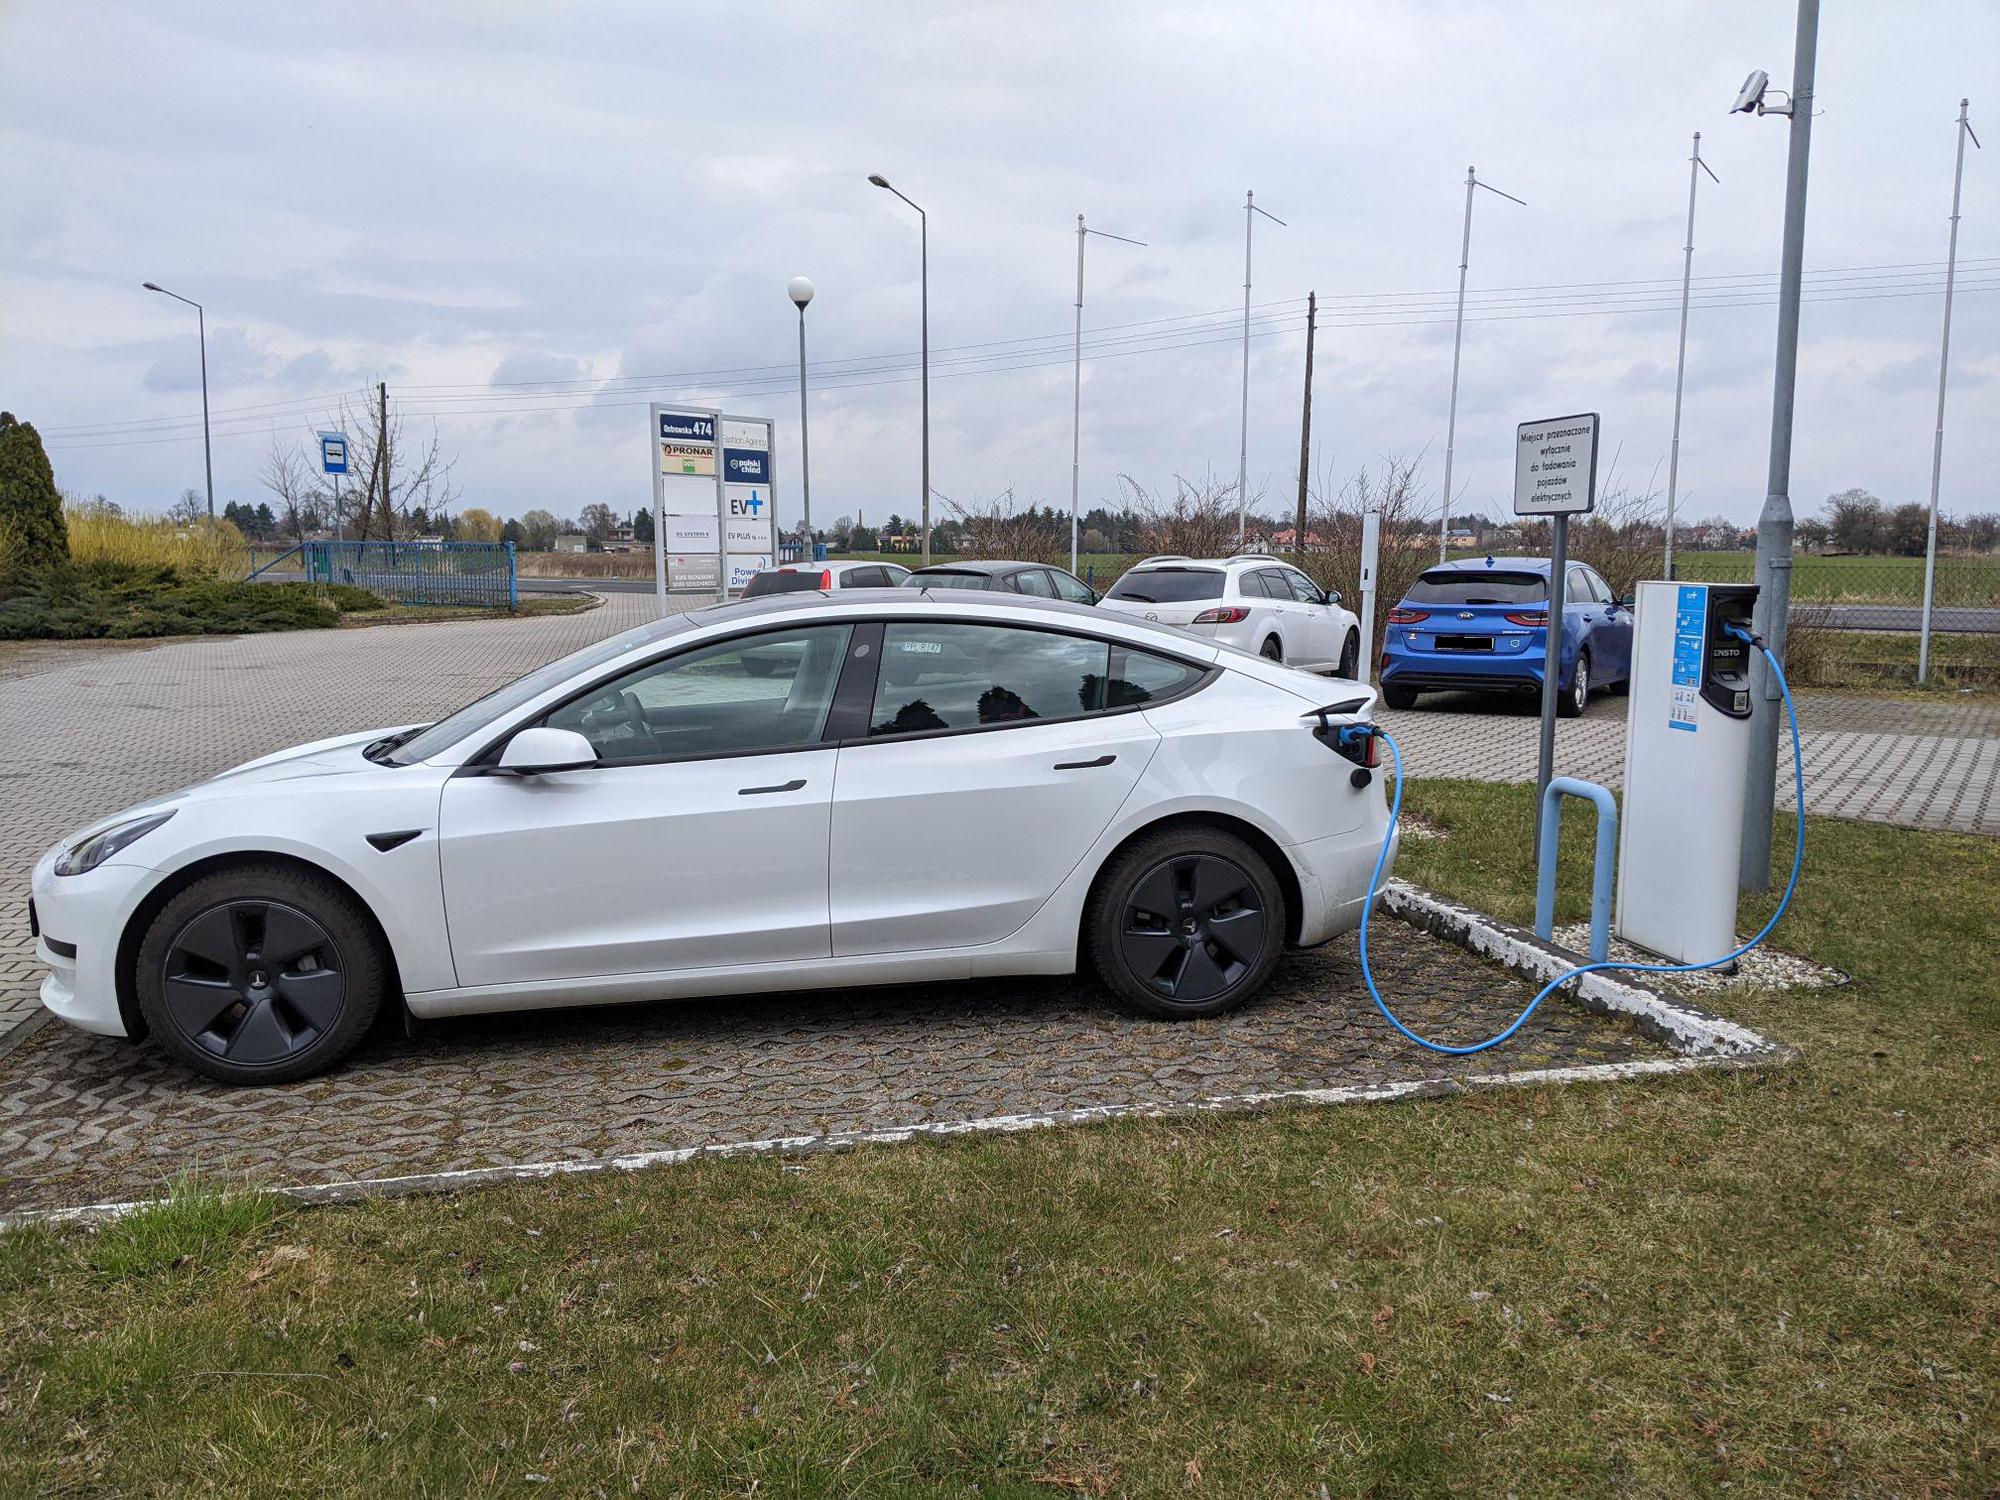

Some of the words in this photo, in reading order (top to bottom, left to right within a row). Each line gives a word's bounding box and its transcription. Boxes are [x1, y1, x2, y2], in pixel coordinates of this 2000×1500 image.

[693, 421, 713, 436] 474
[1520, 432, 1544, 444] Miejsce
[1547, 426, 1590, 441] przeznaczone
[745, 436, 767, 448] Agency
[673, 446, 713, 456] PRONAR
[739, 459, 760, 467] polski
[1530, 461, 1539, 472] do
[1531, 491, 1571, 504] elektrycznych
[727, 532, 736, 540] EV
[736, 532, 751, 540] PLUS
[734, 567, 760, 577] Power
[1713, 649, 1740, 657] ENSTO
